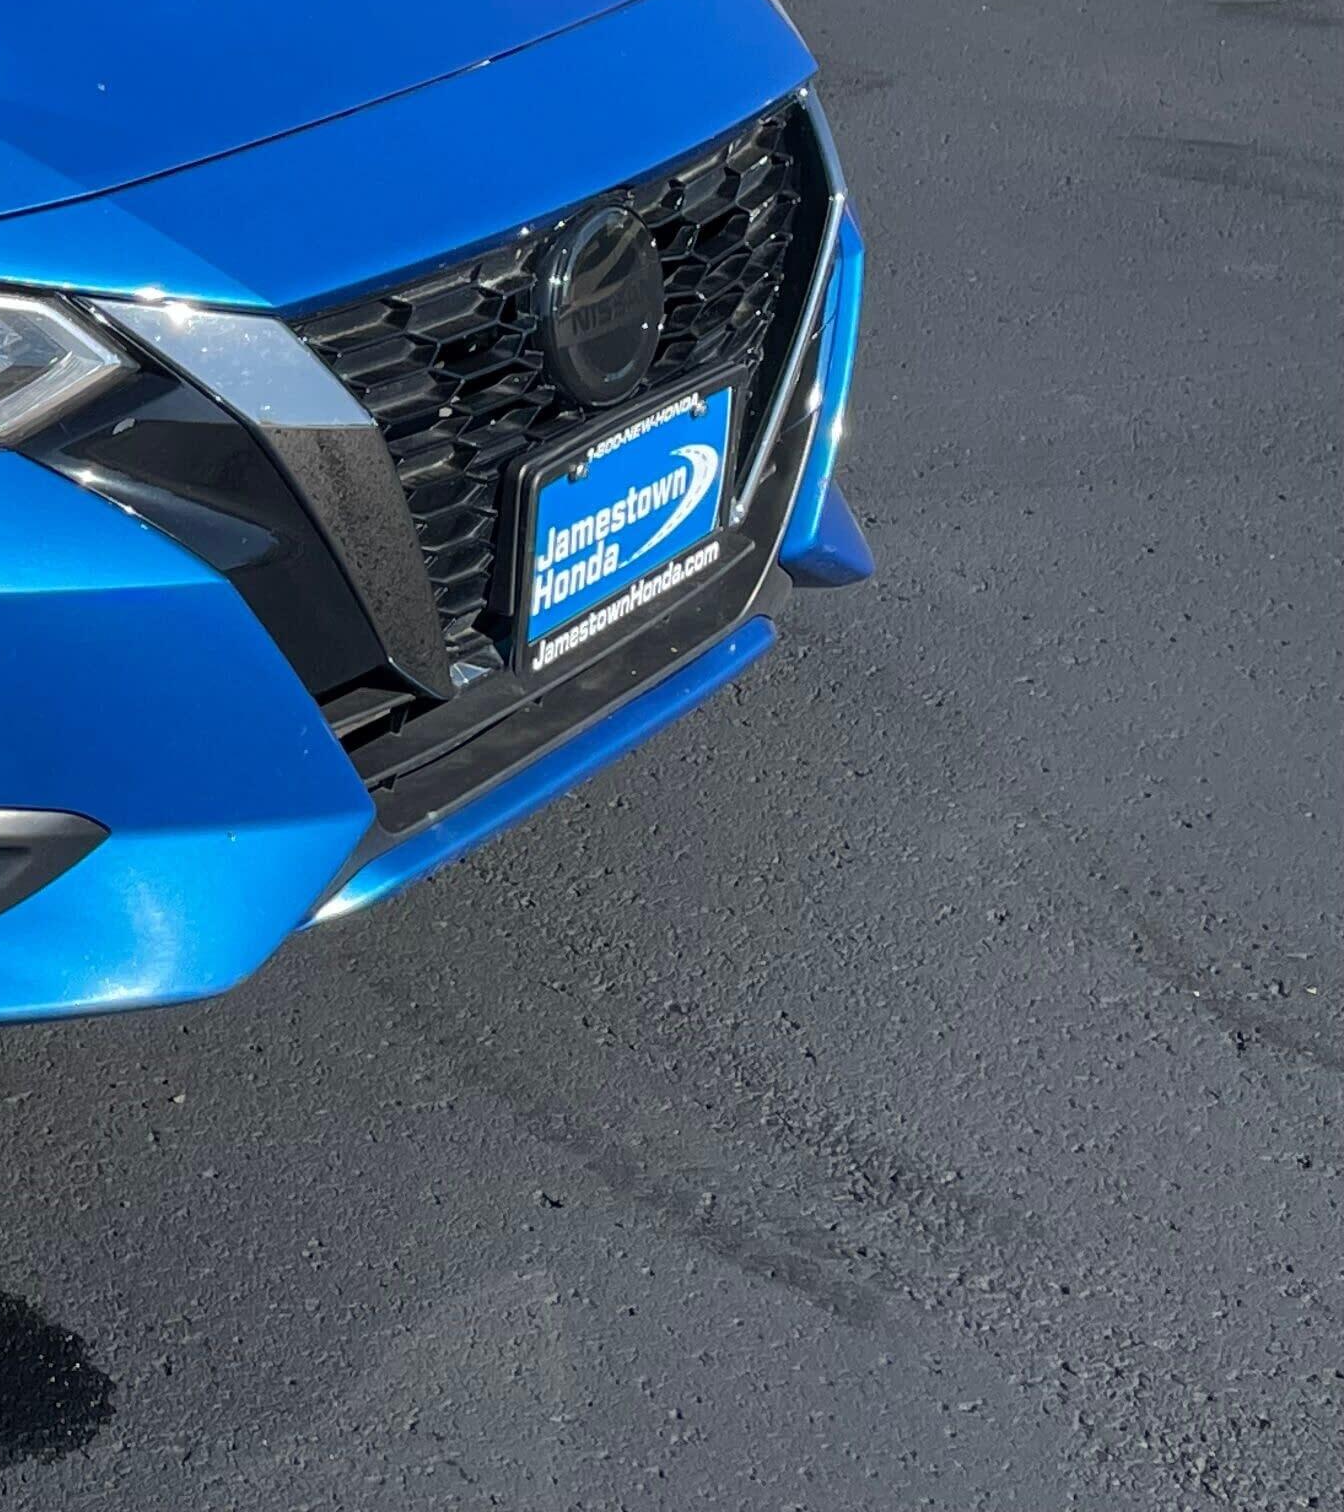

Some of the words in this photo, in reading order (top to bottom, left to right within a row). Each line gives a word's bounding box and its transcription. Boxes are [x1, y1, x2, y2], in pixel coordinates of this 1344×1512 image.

[536, 465, 688, 572] Jamestown
[531, 539, 621, 616] Honda
[531, 540, 720, 671] JamestownHonda.com
